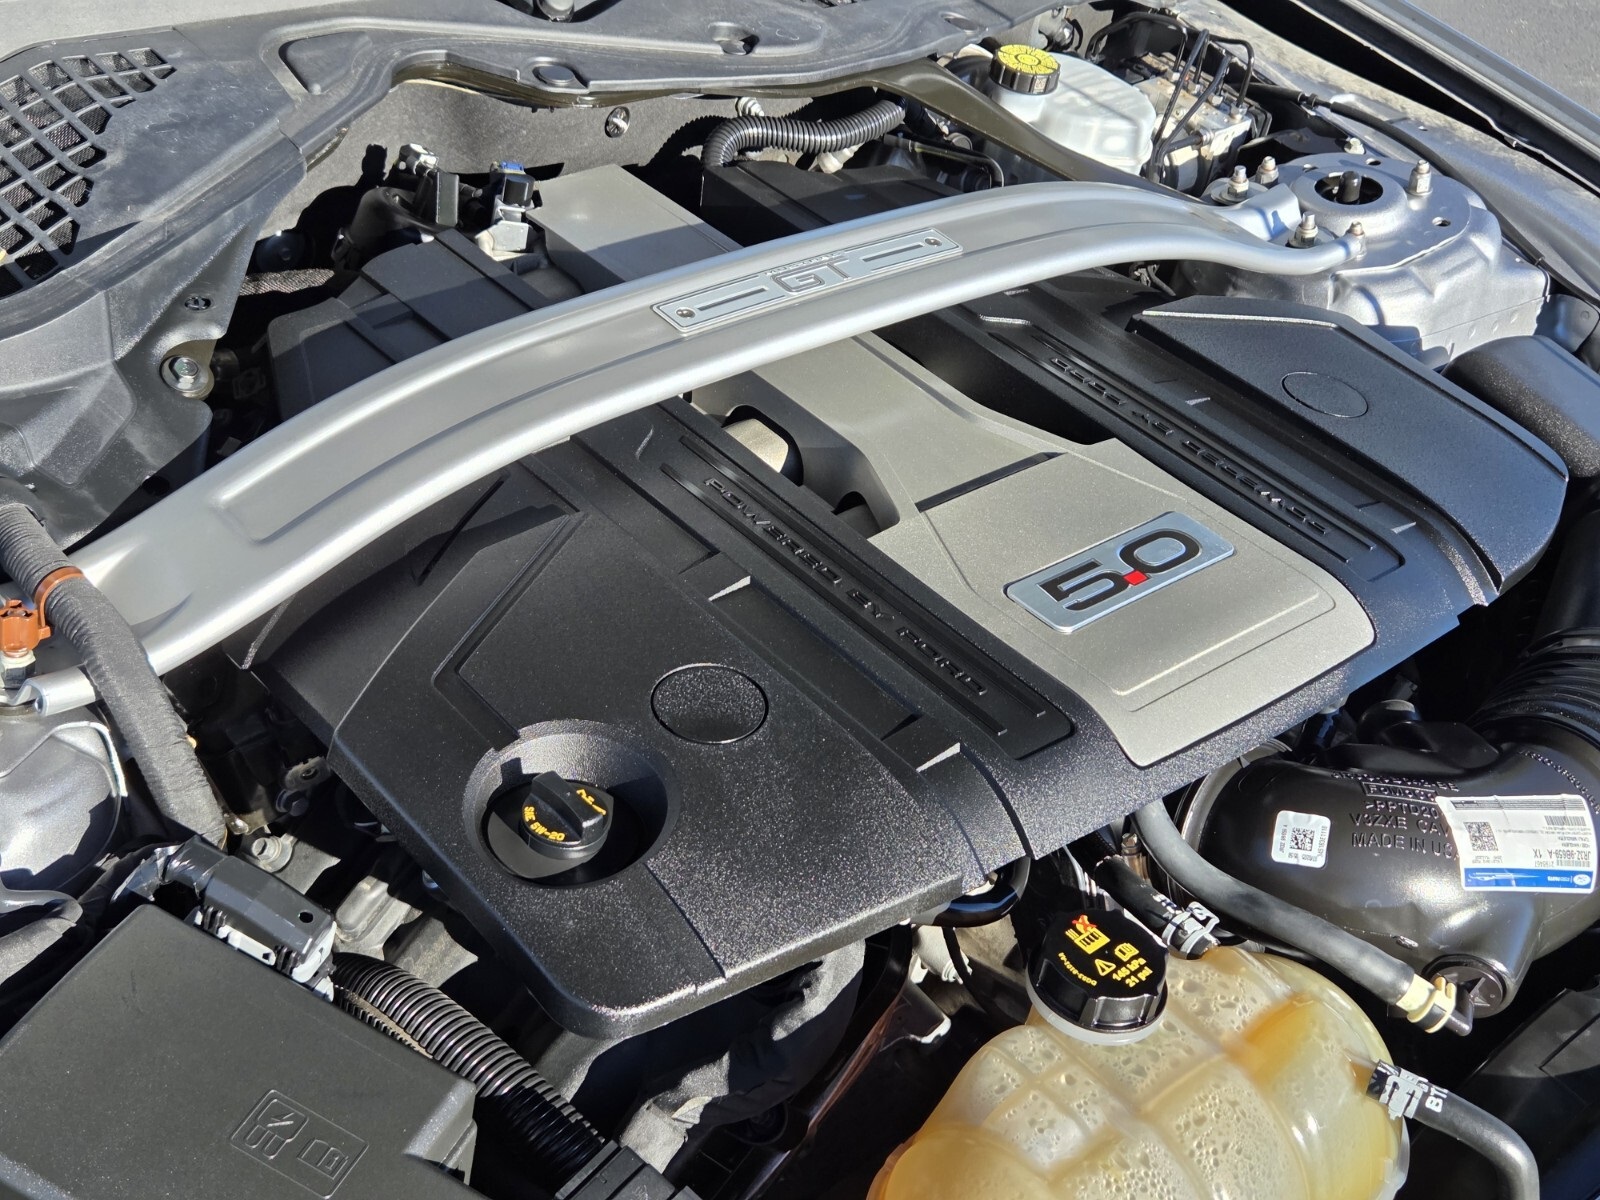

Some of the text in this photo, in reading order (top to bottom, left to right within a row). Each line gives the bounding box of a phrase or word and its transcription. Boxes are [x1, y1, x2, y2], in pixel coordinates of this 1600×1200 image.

[770, 258, 850, 293] GT
[1036, 527, 1203, 611] 5.0
[703, 477, 988, 696] POWERED BY FORD
[530, 821, 566, 841] 5W-20
[1351, 832, 1406, 851] MADE
[1409, 836, 1427, 854] IN
[1125, 974, 1140, 988] 21
